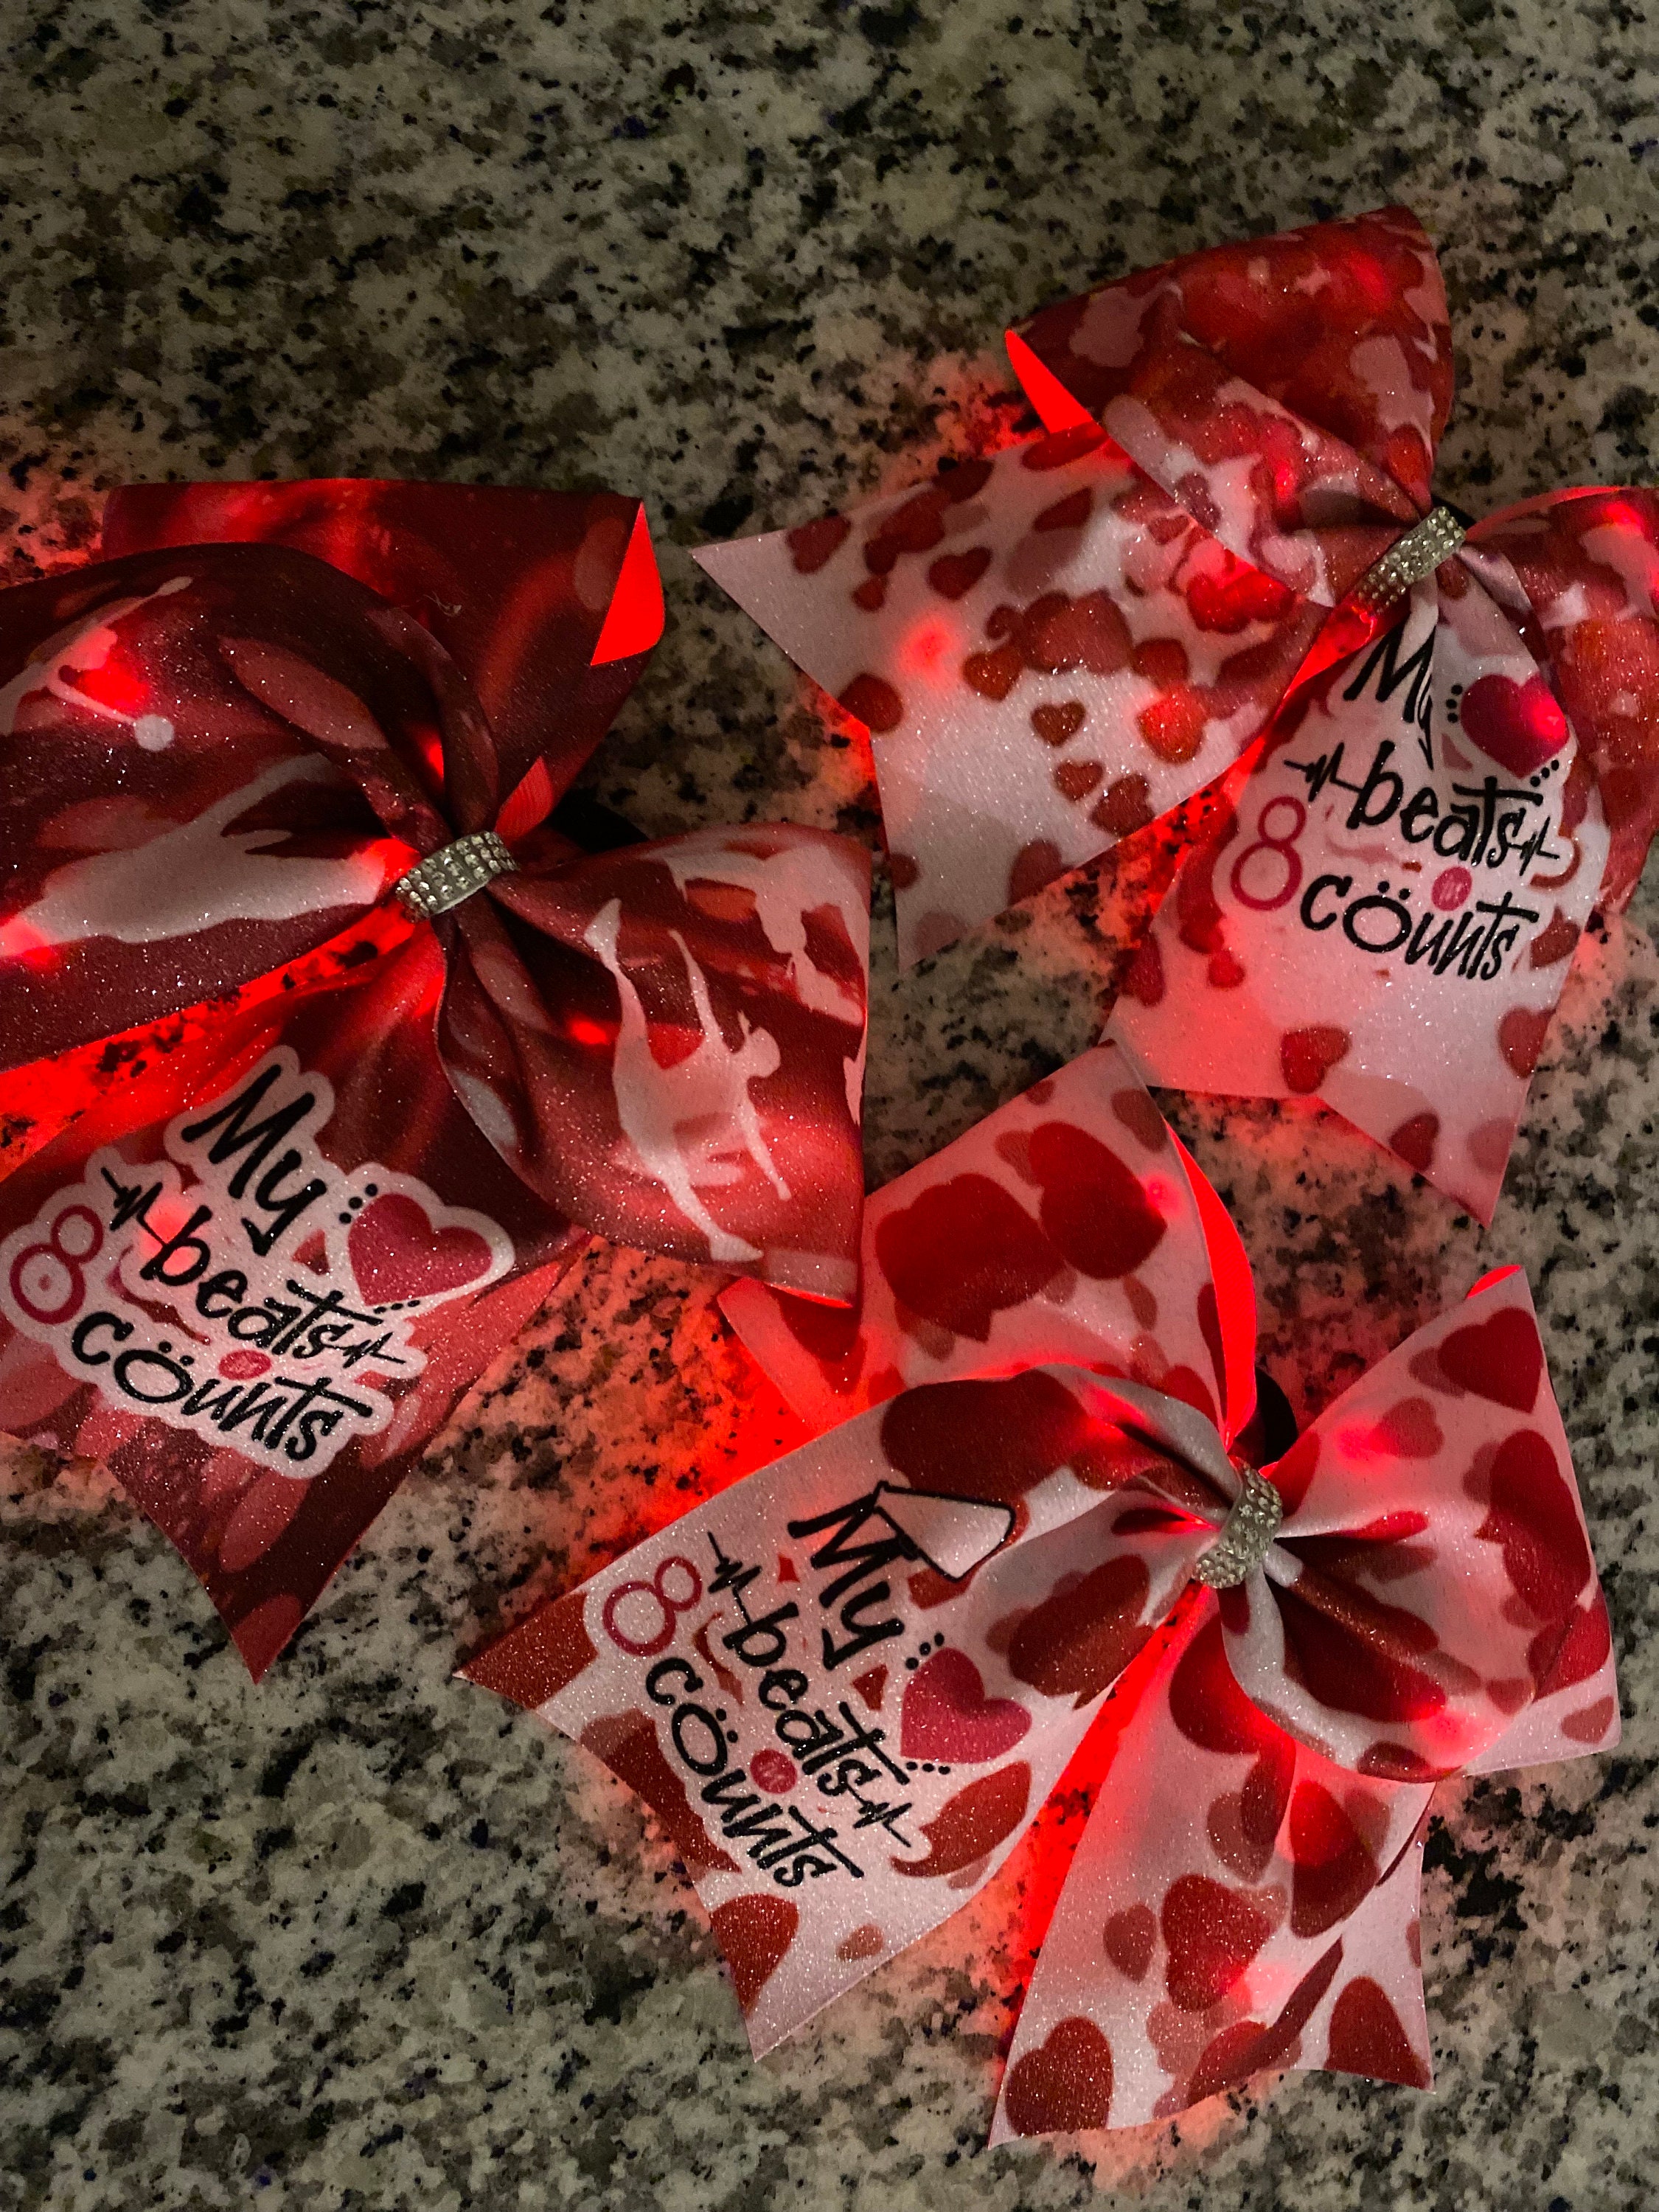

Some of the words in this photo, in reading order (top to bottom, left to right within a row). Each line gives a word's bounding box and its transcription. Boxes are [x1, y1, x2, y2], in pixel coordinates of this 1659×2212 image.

[1231, 796, 1307, 911] 8
[1347, 740, 1544, 869] beats
[181, 1064, 327, 1256] My
[9, 1205, 104, 1325] 8
[139, 1205, 383, 1357] beats
[602, 1556, 703, 1657] 8
[787, 1488, 917, 1671] My
[722, 1601, 910, 1797] beats
